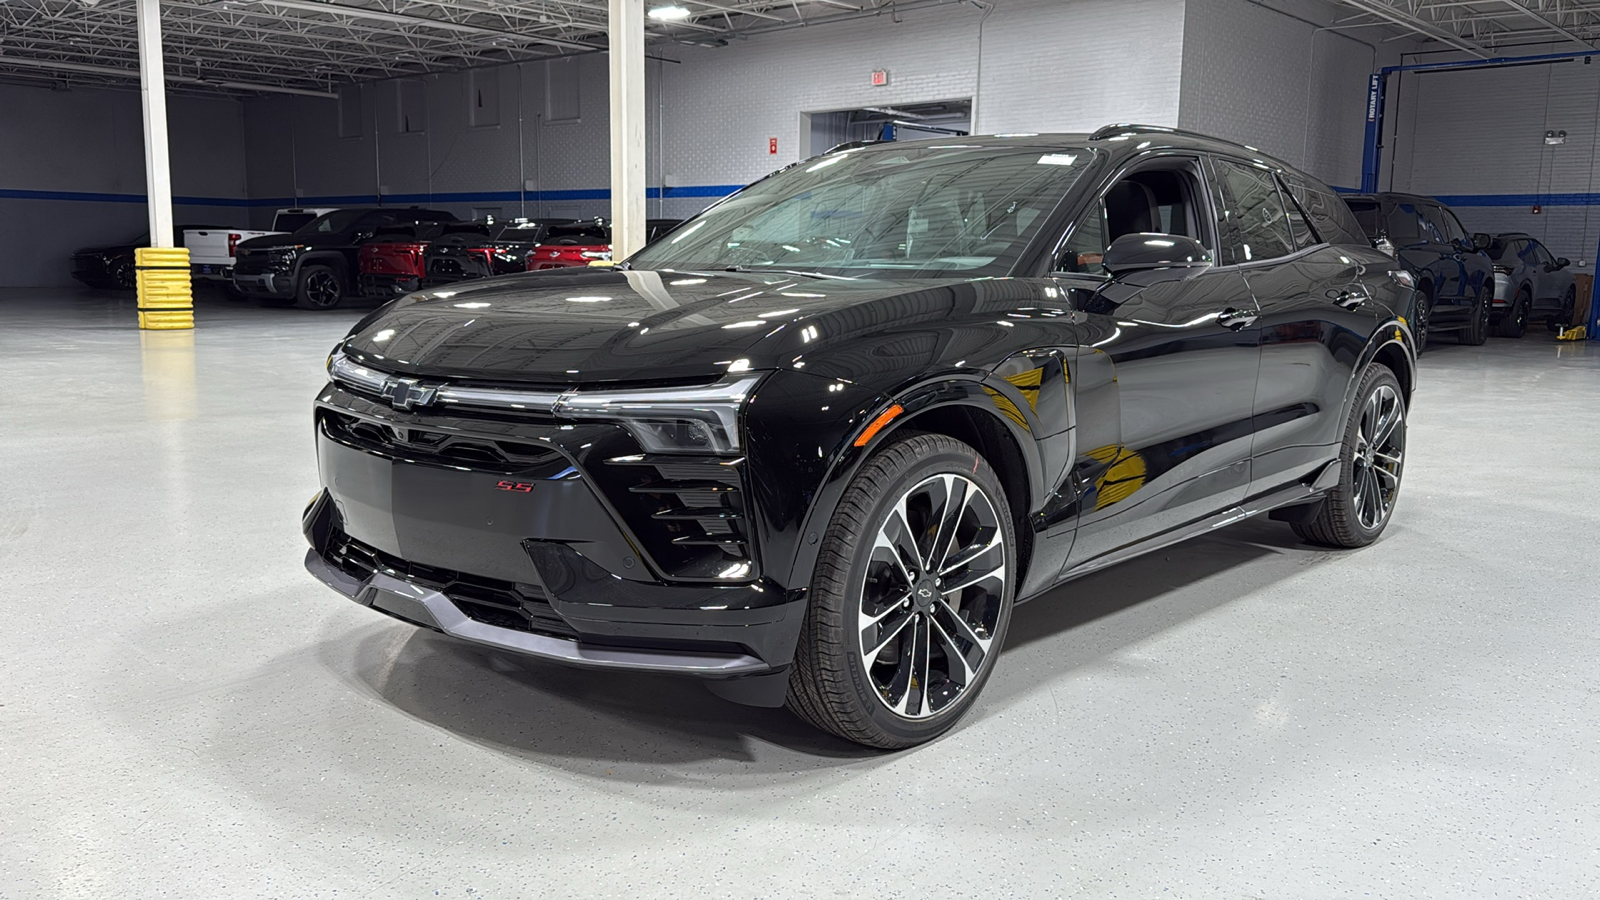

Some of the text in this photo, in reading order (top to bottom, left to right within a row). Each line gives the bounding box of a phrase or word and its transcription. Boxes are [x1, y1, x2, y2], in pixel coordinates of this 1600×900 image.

[1368, 75, 1379, 118] ROTARY LIFT
[495, 480, 533, 492] SS
[848, 654, 867, 701] MICHELIN
